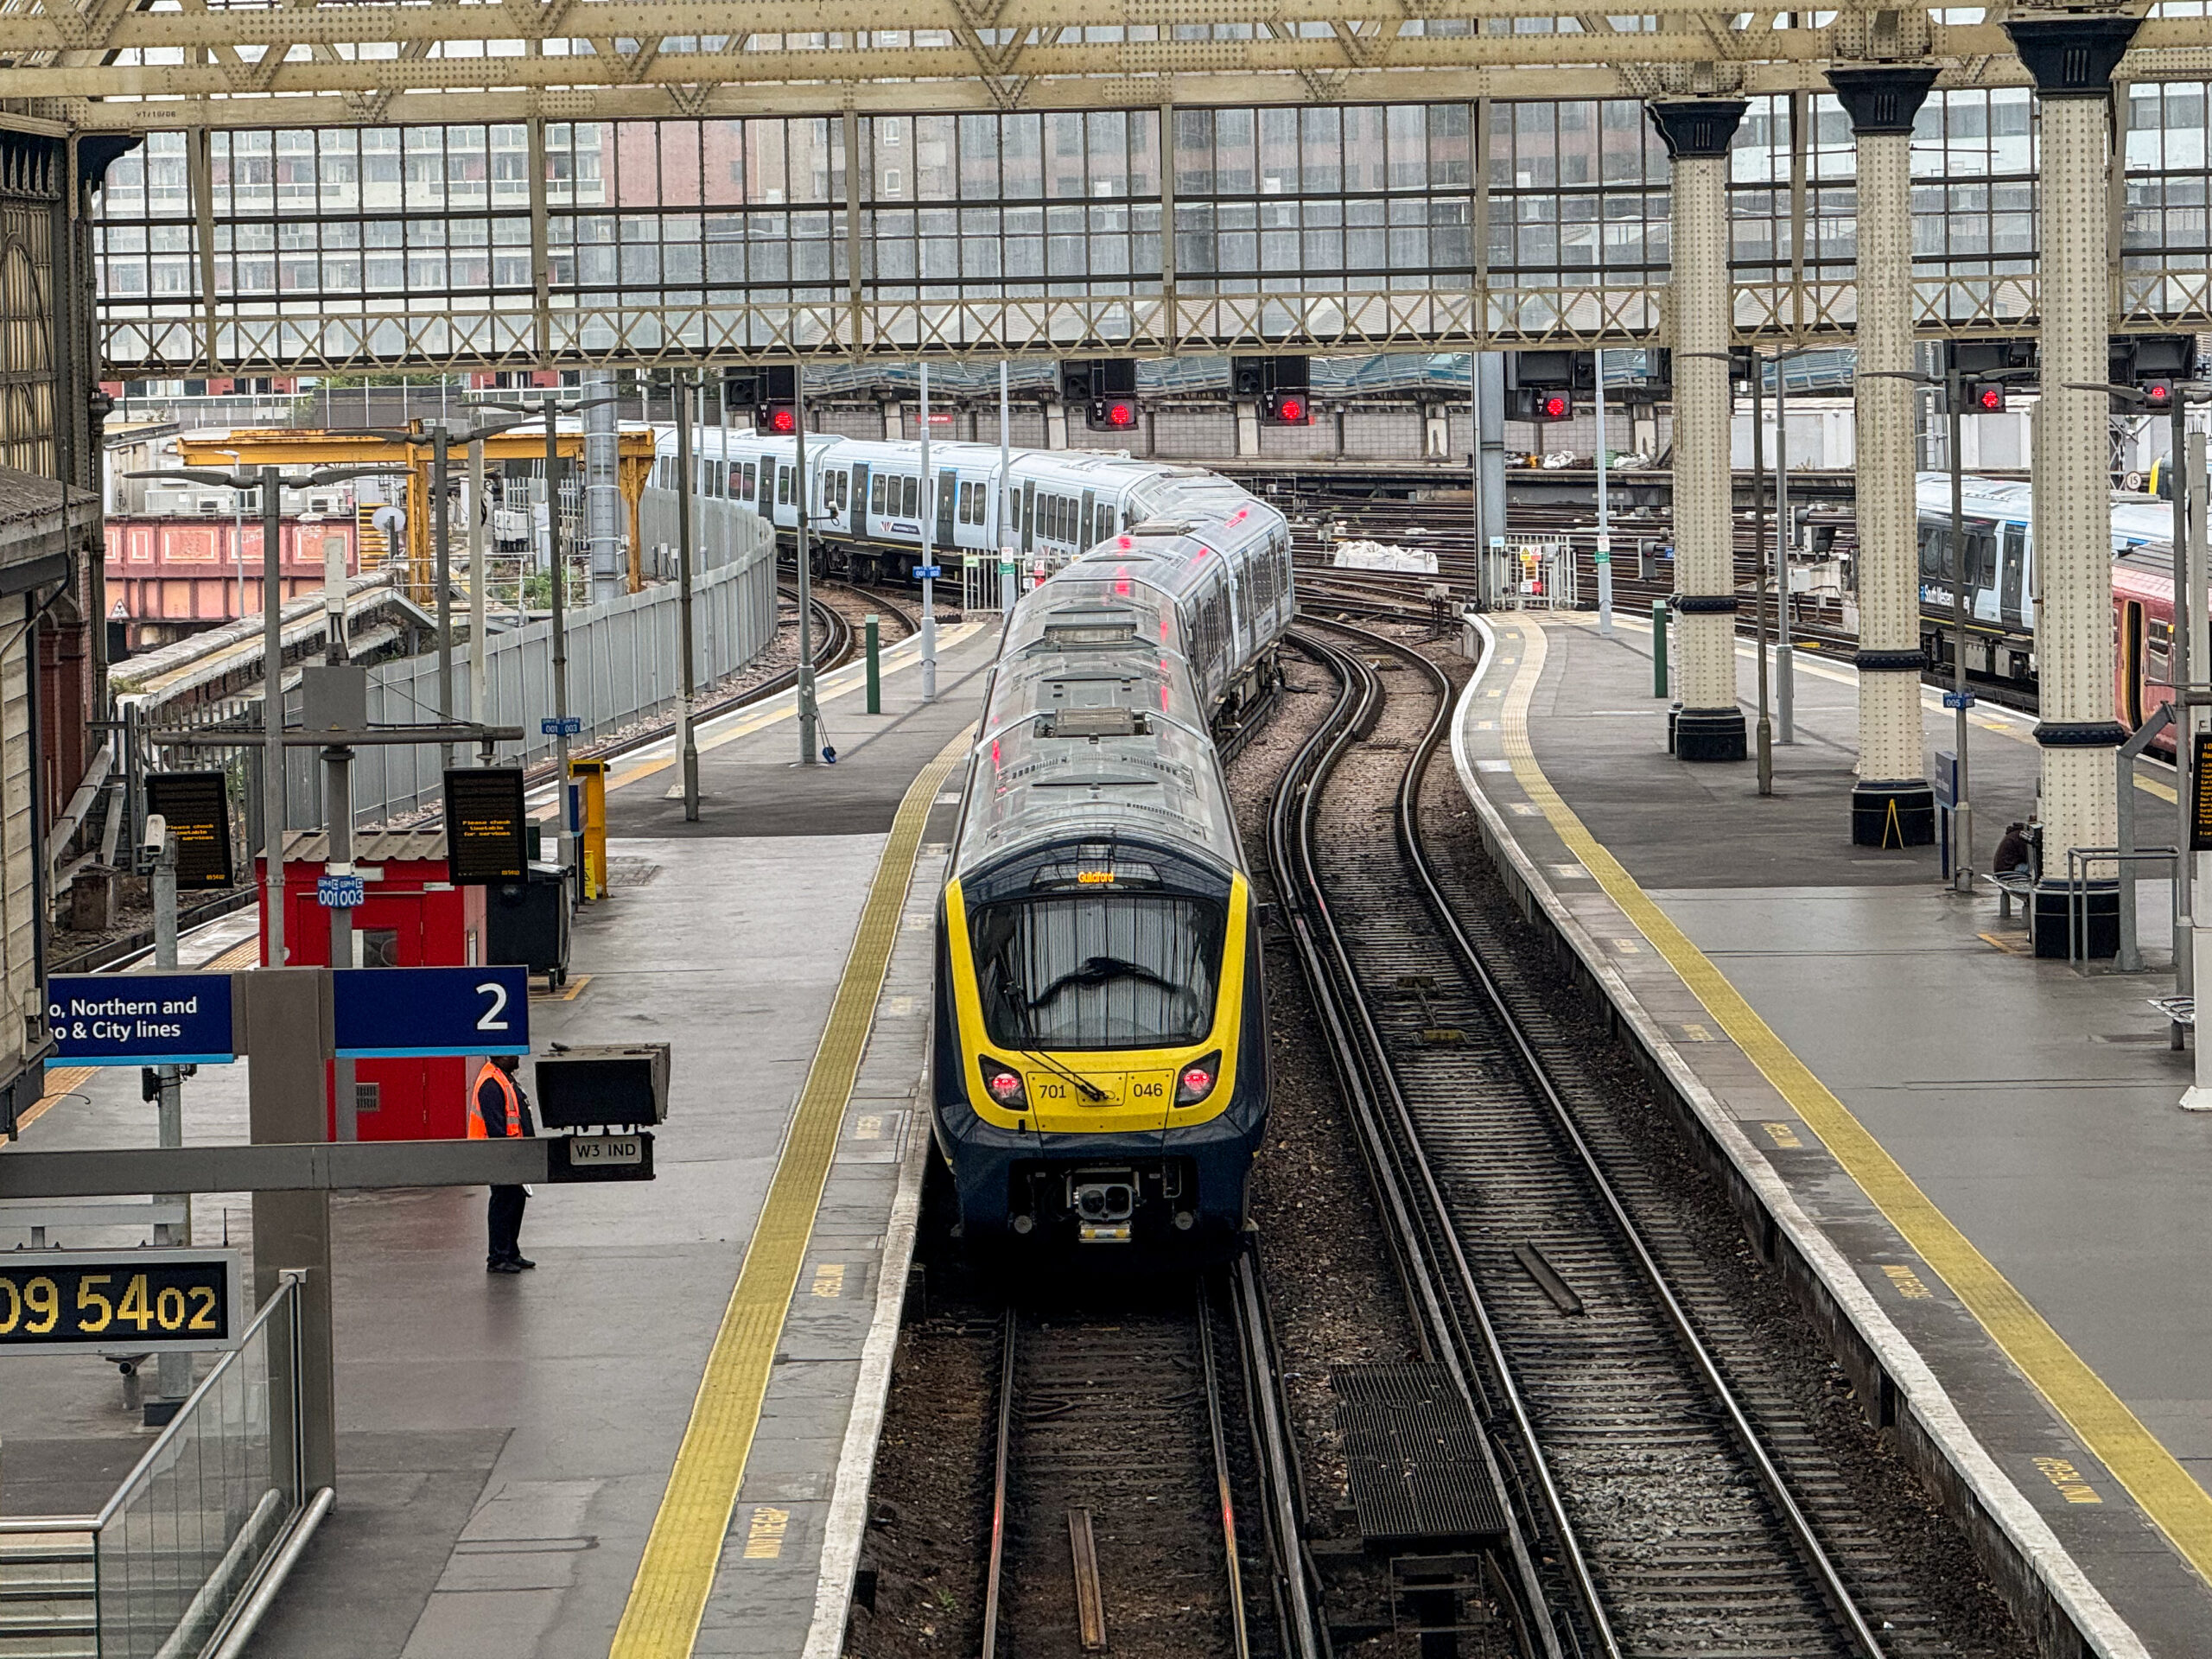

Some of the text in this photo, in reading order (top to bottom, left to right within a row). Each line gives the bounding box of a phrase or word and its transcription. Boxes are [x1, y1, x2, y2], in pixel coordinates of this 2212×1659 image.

[2130, 476, 2139, 485] 15
[1946, 699, 1961, 708] 005
[545, 724, 558, 734] 001
[564, 724, 578, 734] 003
[1077, 870, 1115, 883] Guildford
[319, 889, 339, 906] 001
[339, 889, 364, 906] 003
[71, 998, 157, 1016] Northern
[162, 996, 198, 1014] and
[476, 982, 508, 1030] 2
[72, 1021, 88, 1039] &
[92, 1020, 131, 1042] City
[137, 1020, 181, 1038] lines
[1039, 1083, 1163, 1099] 701 046
[575, 1143, 636, 1158] W3 IND
